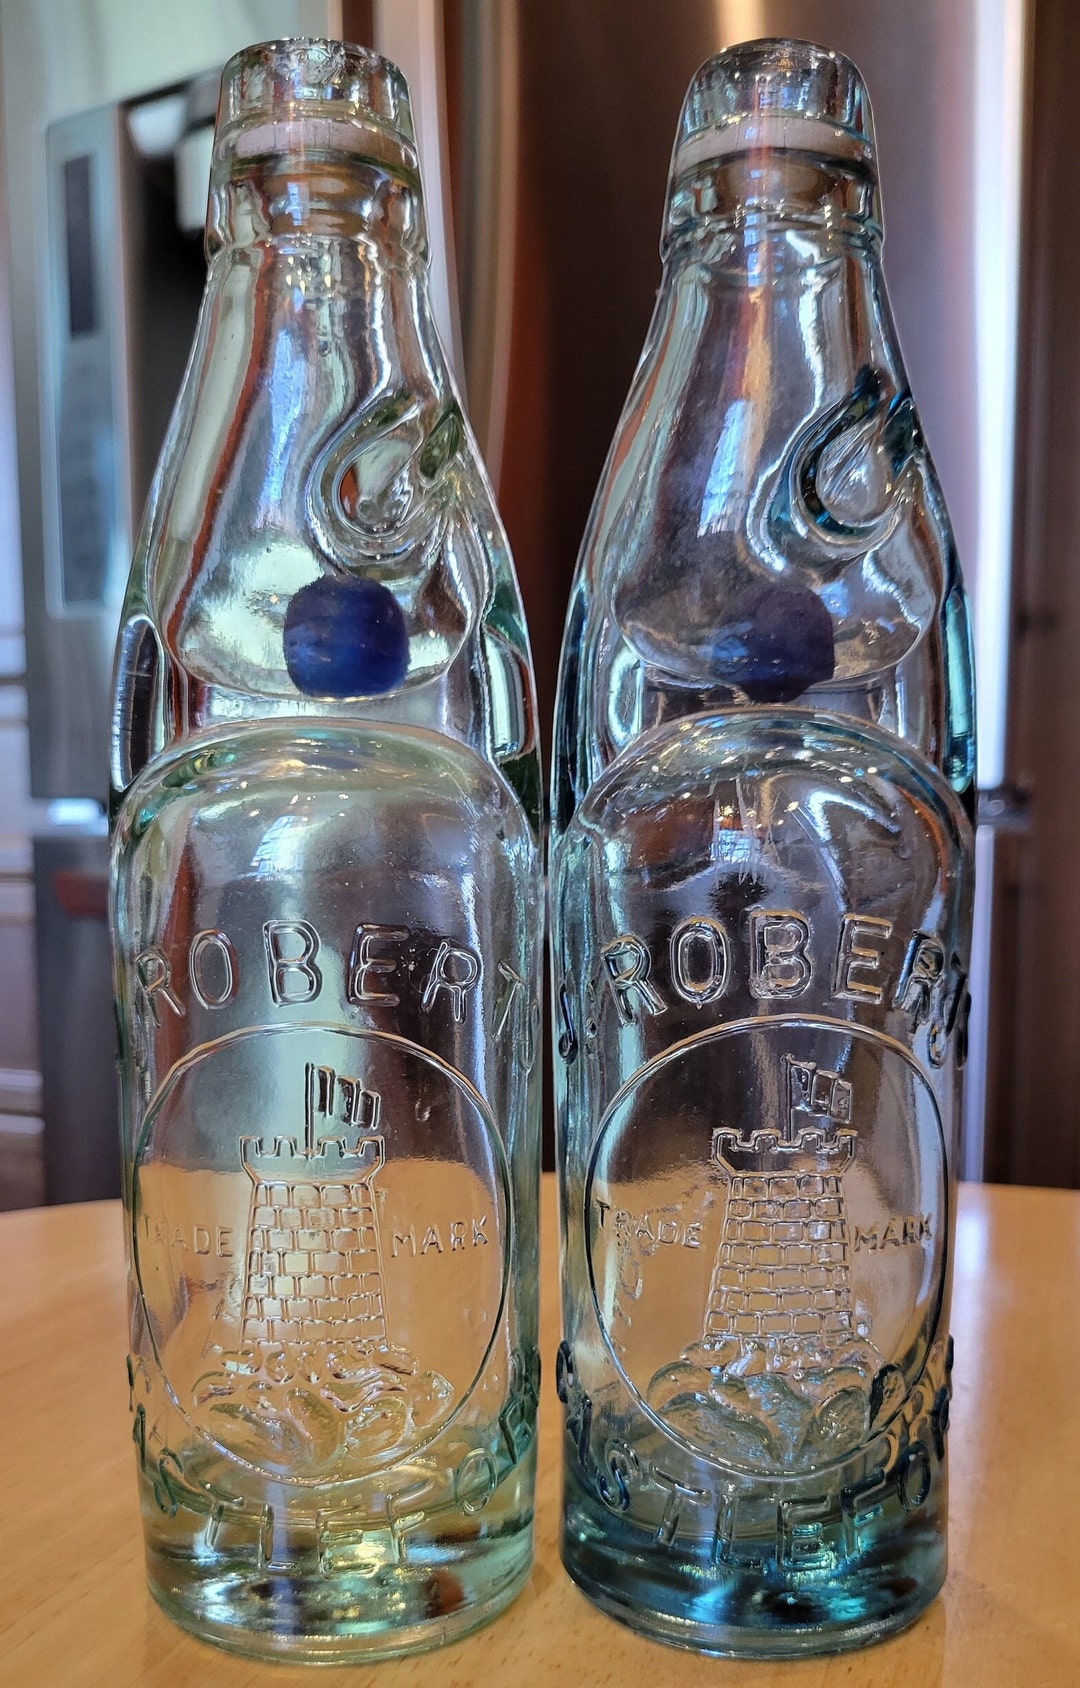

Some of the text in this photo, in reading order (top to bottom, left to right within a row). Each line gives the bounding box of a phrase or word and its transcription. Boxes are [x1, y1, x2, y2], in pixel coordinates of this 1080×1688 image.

[390, 1215, 489, 1257] MARK
[595, 1198, 933, 1254] TRADE MARK
